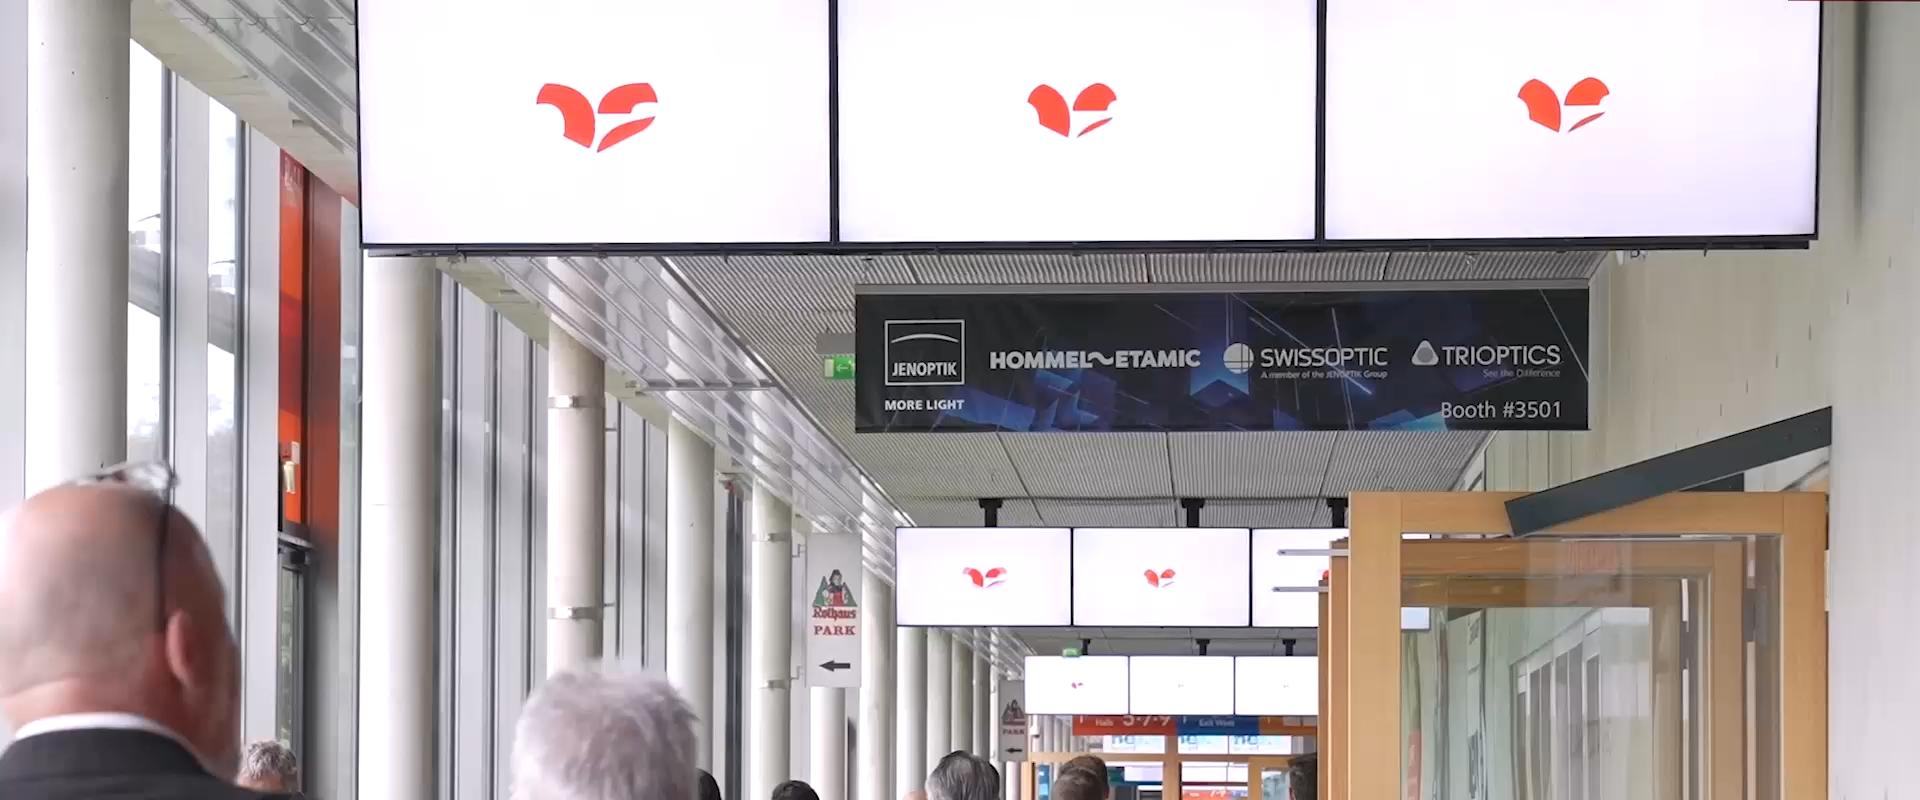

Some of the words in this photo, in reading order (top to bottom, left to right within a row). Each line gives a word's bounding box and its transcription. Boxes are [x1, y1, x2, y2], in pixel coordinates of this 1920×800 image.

[1260, 347, 1388, 367] SWISSOPTIC
[1442, 345, 1561, 366] TRIOPTICS
[891, 362, 957, 377] JENOPTIK
[1268, 371, 1300, 379] member
[1301, 371, 1310, 379] of
[1311, 371, 1324, 379] the
[1363, 370, 1388, 379] Group
[885, 399, 923, 411] MORE
[926, 399, 965, 411] LIGHT
[1441, 401, 1496, 419] Booth
[1503, 401, 1561, 419] #3501
[814, 625, 856, 635] PARK
